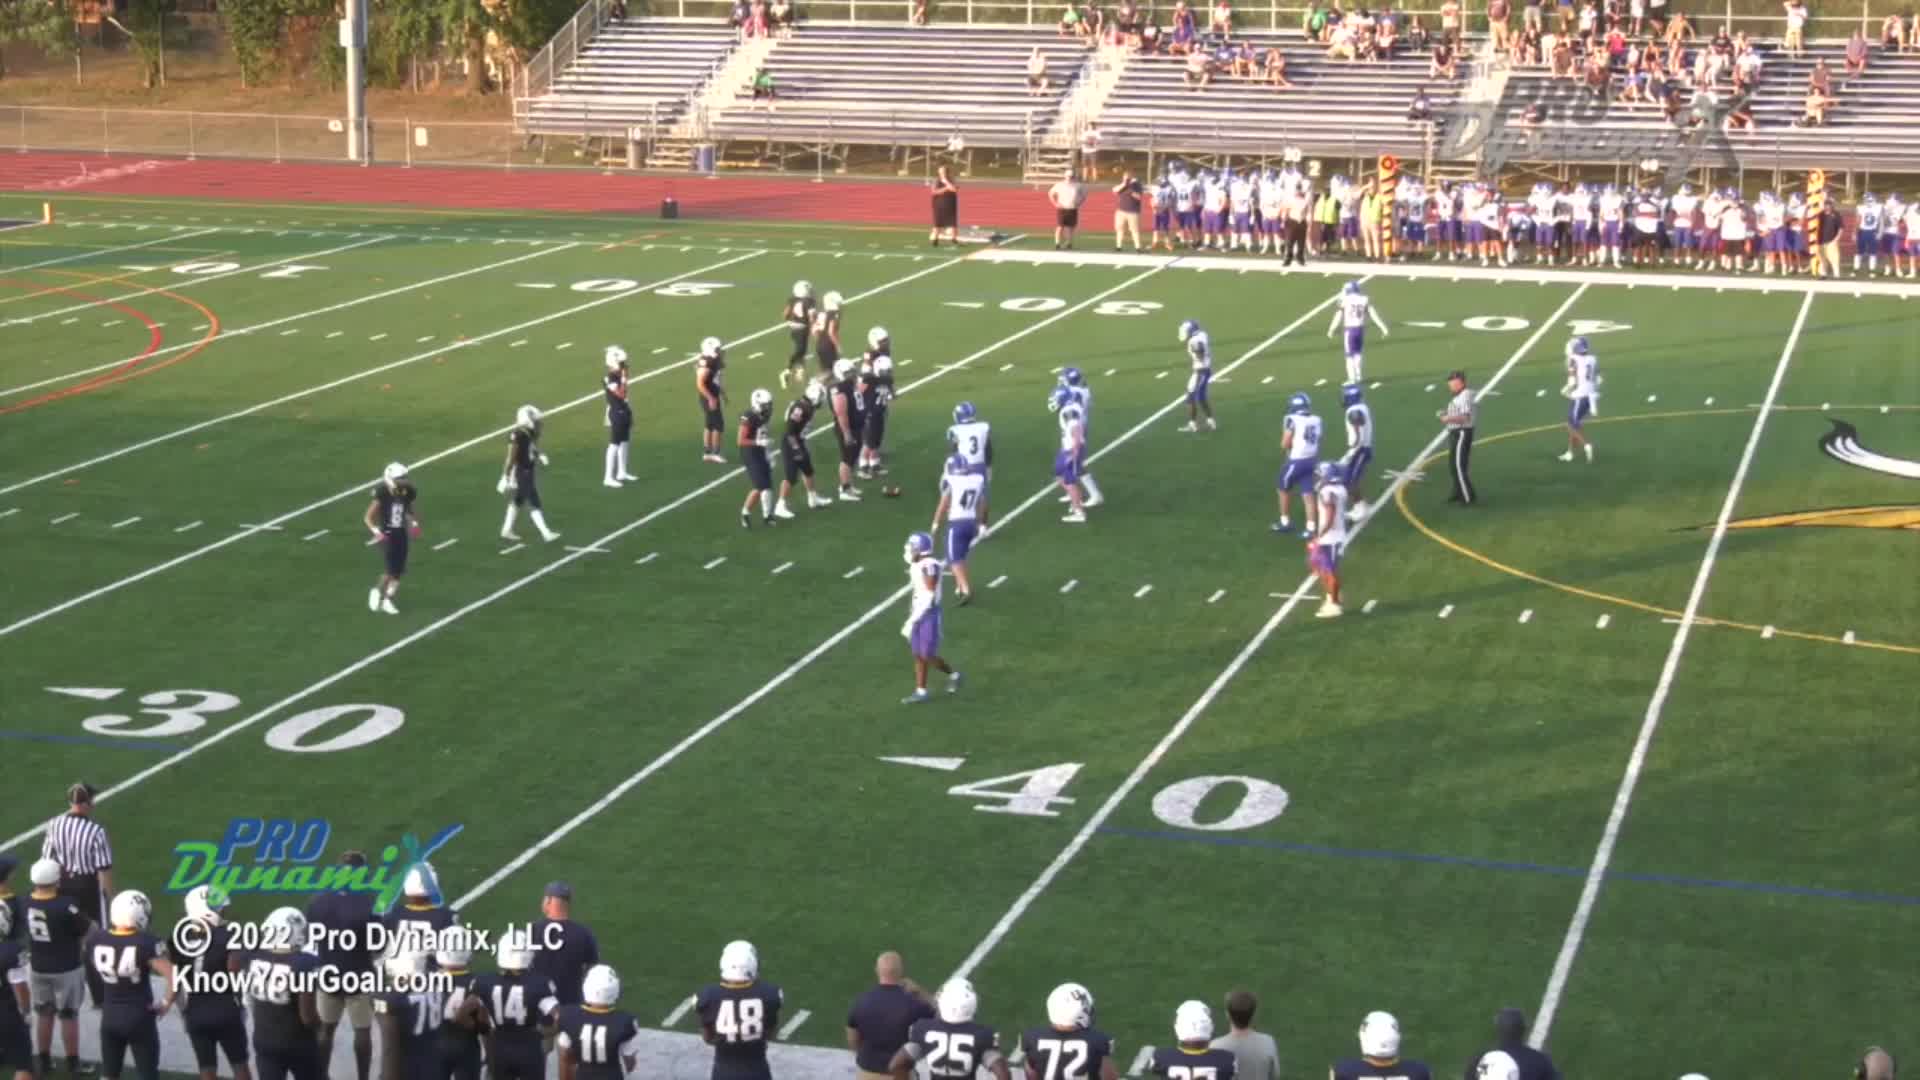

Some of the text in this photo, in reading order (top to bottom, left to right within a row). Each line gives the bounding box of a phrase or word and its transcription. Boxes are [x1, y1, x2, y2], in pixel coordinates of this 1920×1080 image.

[968, 435, 979, 455] 3
[28, 907, 51, 942] 6
[94, 945, 141, 984] 84
[492, 985, 528, 1026] 14
[716, 998, 763, 1043] 48
[580, 1023, 607, 1063] 11
[924, 1031, 975, 1077] 25
[1037, 1039, 1089, 1080] 72
